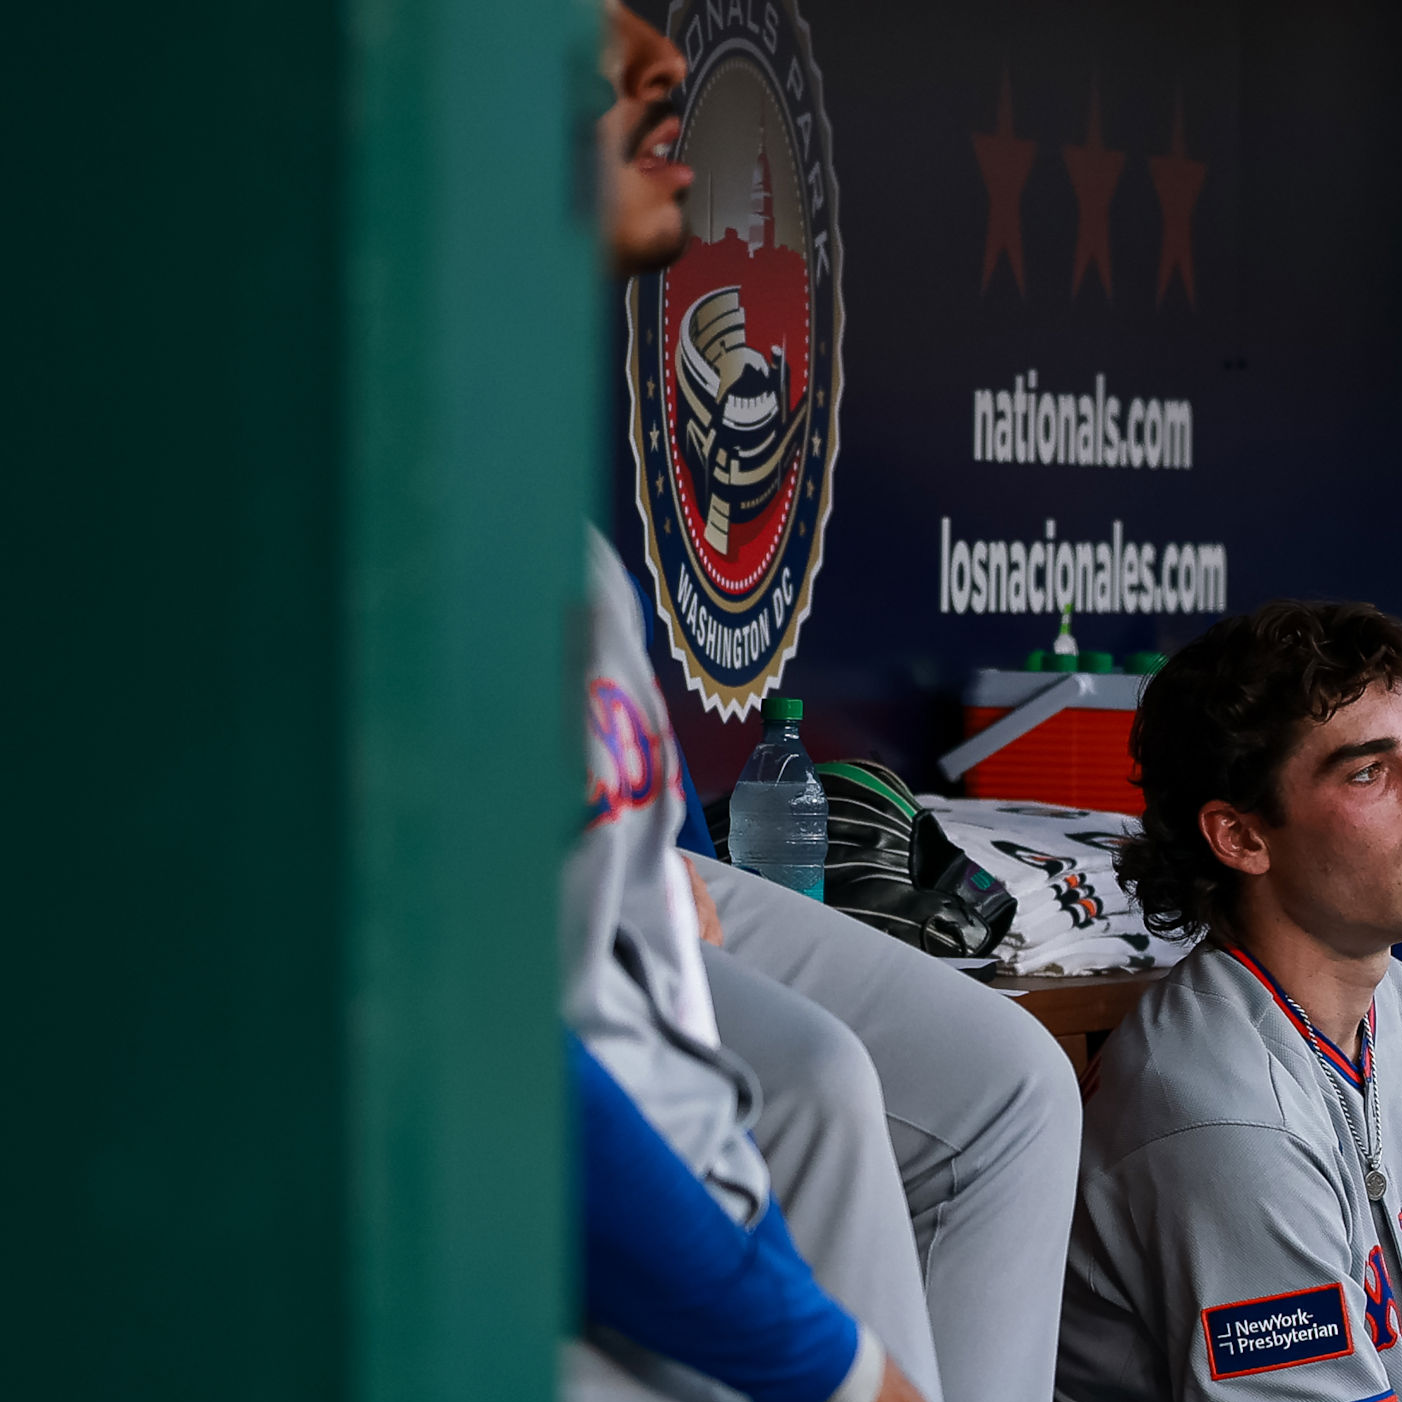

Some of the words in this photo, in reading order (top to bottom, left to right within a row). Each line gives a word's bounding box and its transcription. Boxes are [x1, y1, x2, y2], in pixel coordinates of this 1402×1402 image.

[974, 368, 1194, 470] nationals.com
[941, 516, 1228, 615] losnacionales.com
[676, 562, 771, 670] WASHINGTON
[772, 566, 795, 629] DC
[1235, 1308, 1315, 1338] NewYork-
[1237, 1322, 1340, 1355] Presbyterian
